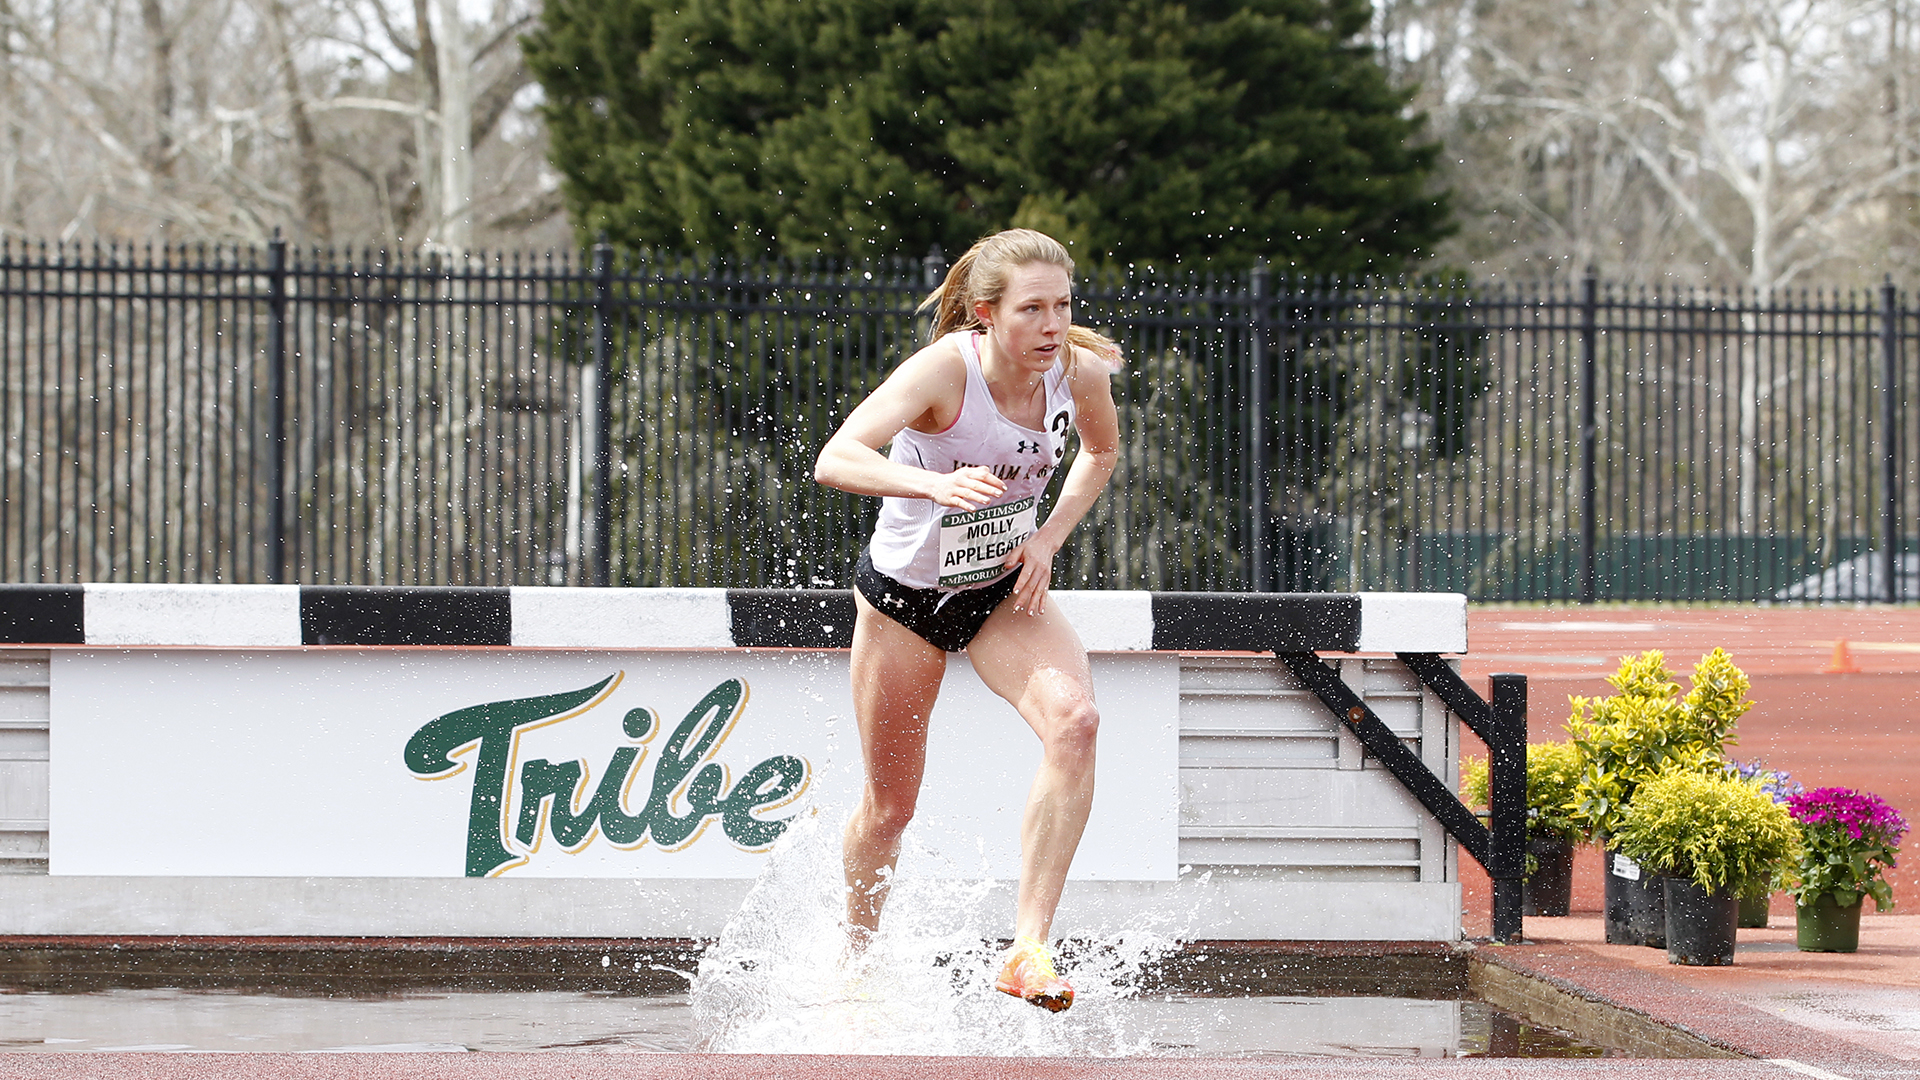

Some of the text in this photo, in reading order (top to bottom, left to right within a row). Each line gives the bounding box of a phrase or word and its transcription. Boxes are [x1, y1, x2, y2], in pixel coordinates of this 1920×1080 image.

[951, 500, 1031, 526] DAN STIMSON
[967, 517, 1015, 540] MOLLY
[944, 531, 1029, 567] APPLEGATE
[948, 568, 1000, 585] MEMORIAL
[403, 670, 813, 878] Tribe
